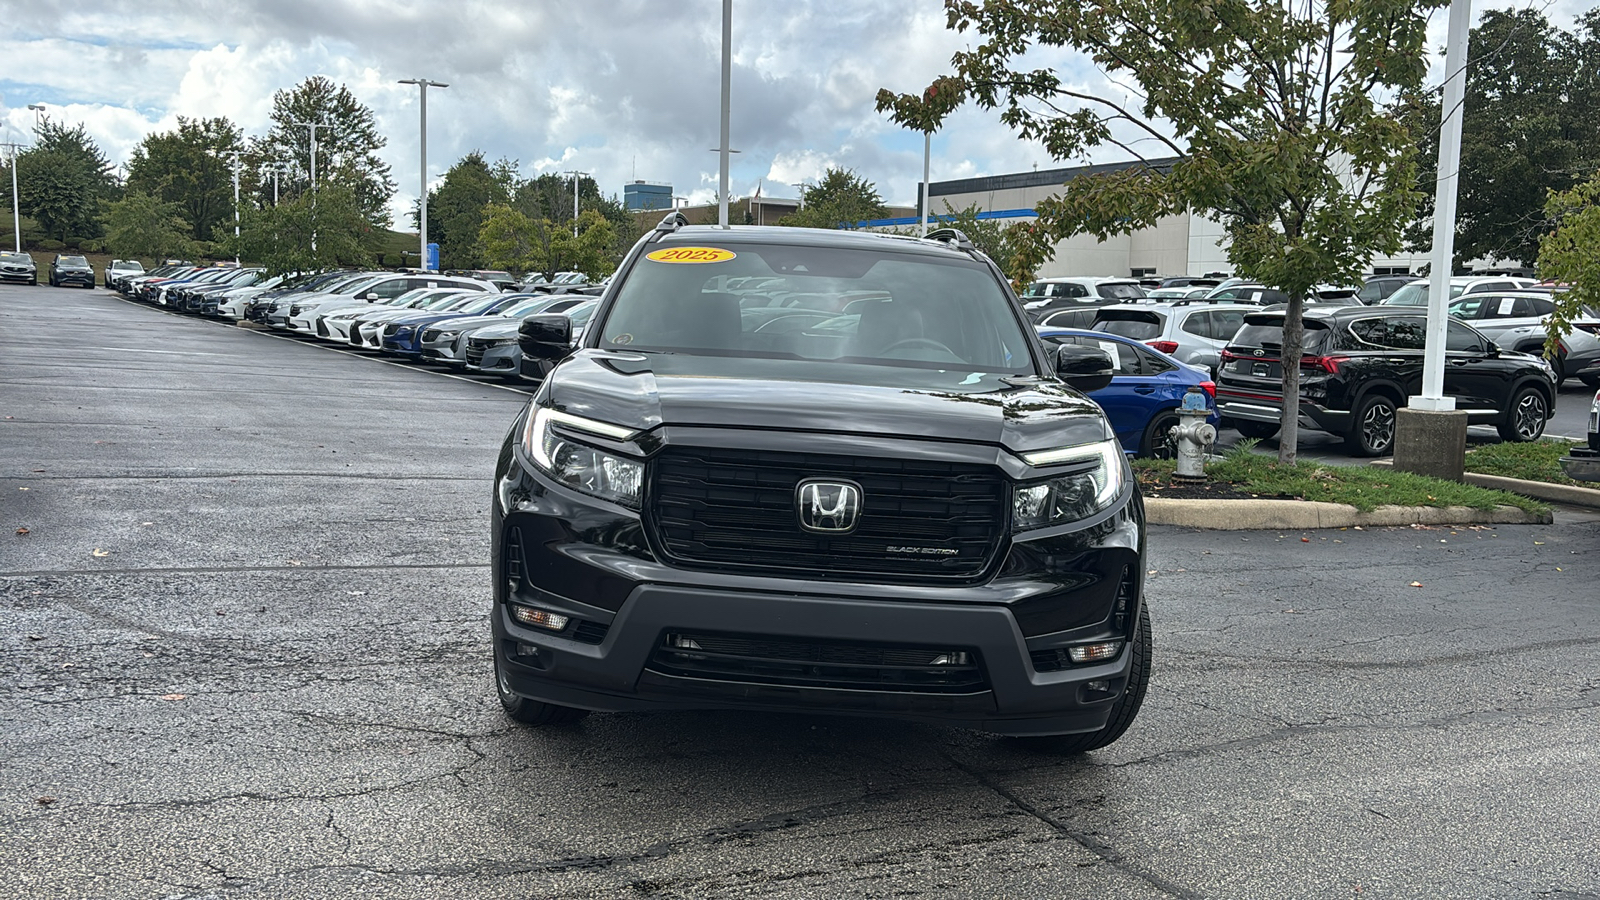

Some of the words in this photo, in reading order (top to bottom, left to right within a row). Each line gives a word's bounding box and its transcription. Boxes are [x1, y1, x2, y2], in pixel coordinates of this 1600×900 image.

[659, 250, 723, 261] 2025
[886, 546, 920, 554] BLACK
[921, 547, 959, 556] EDITION
